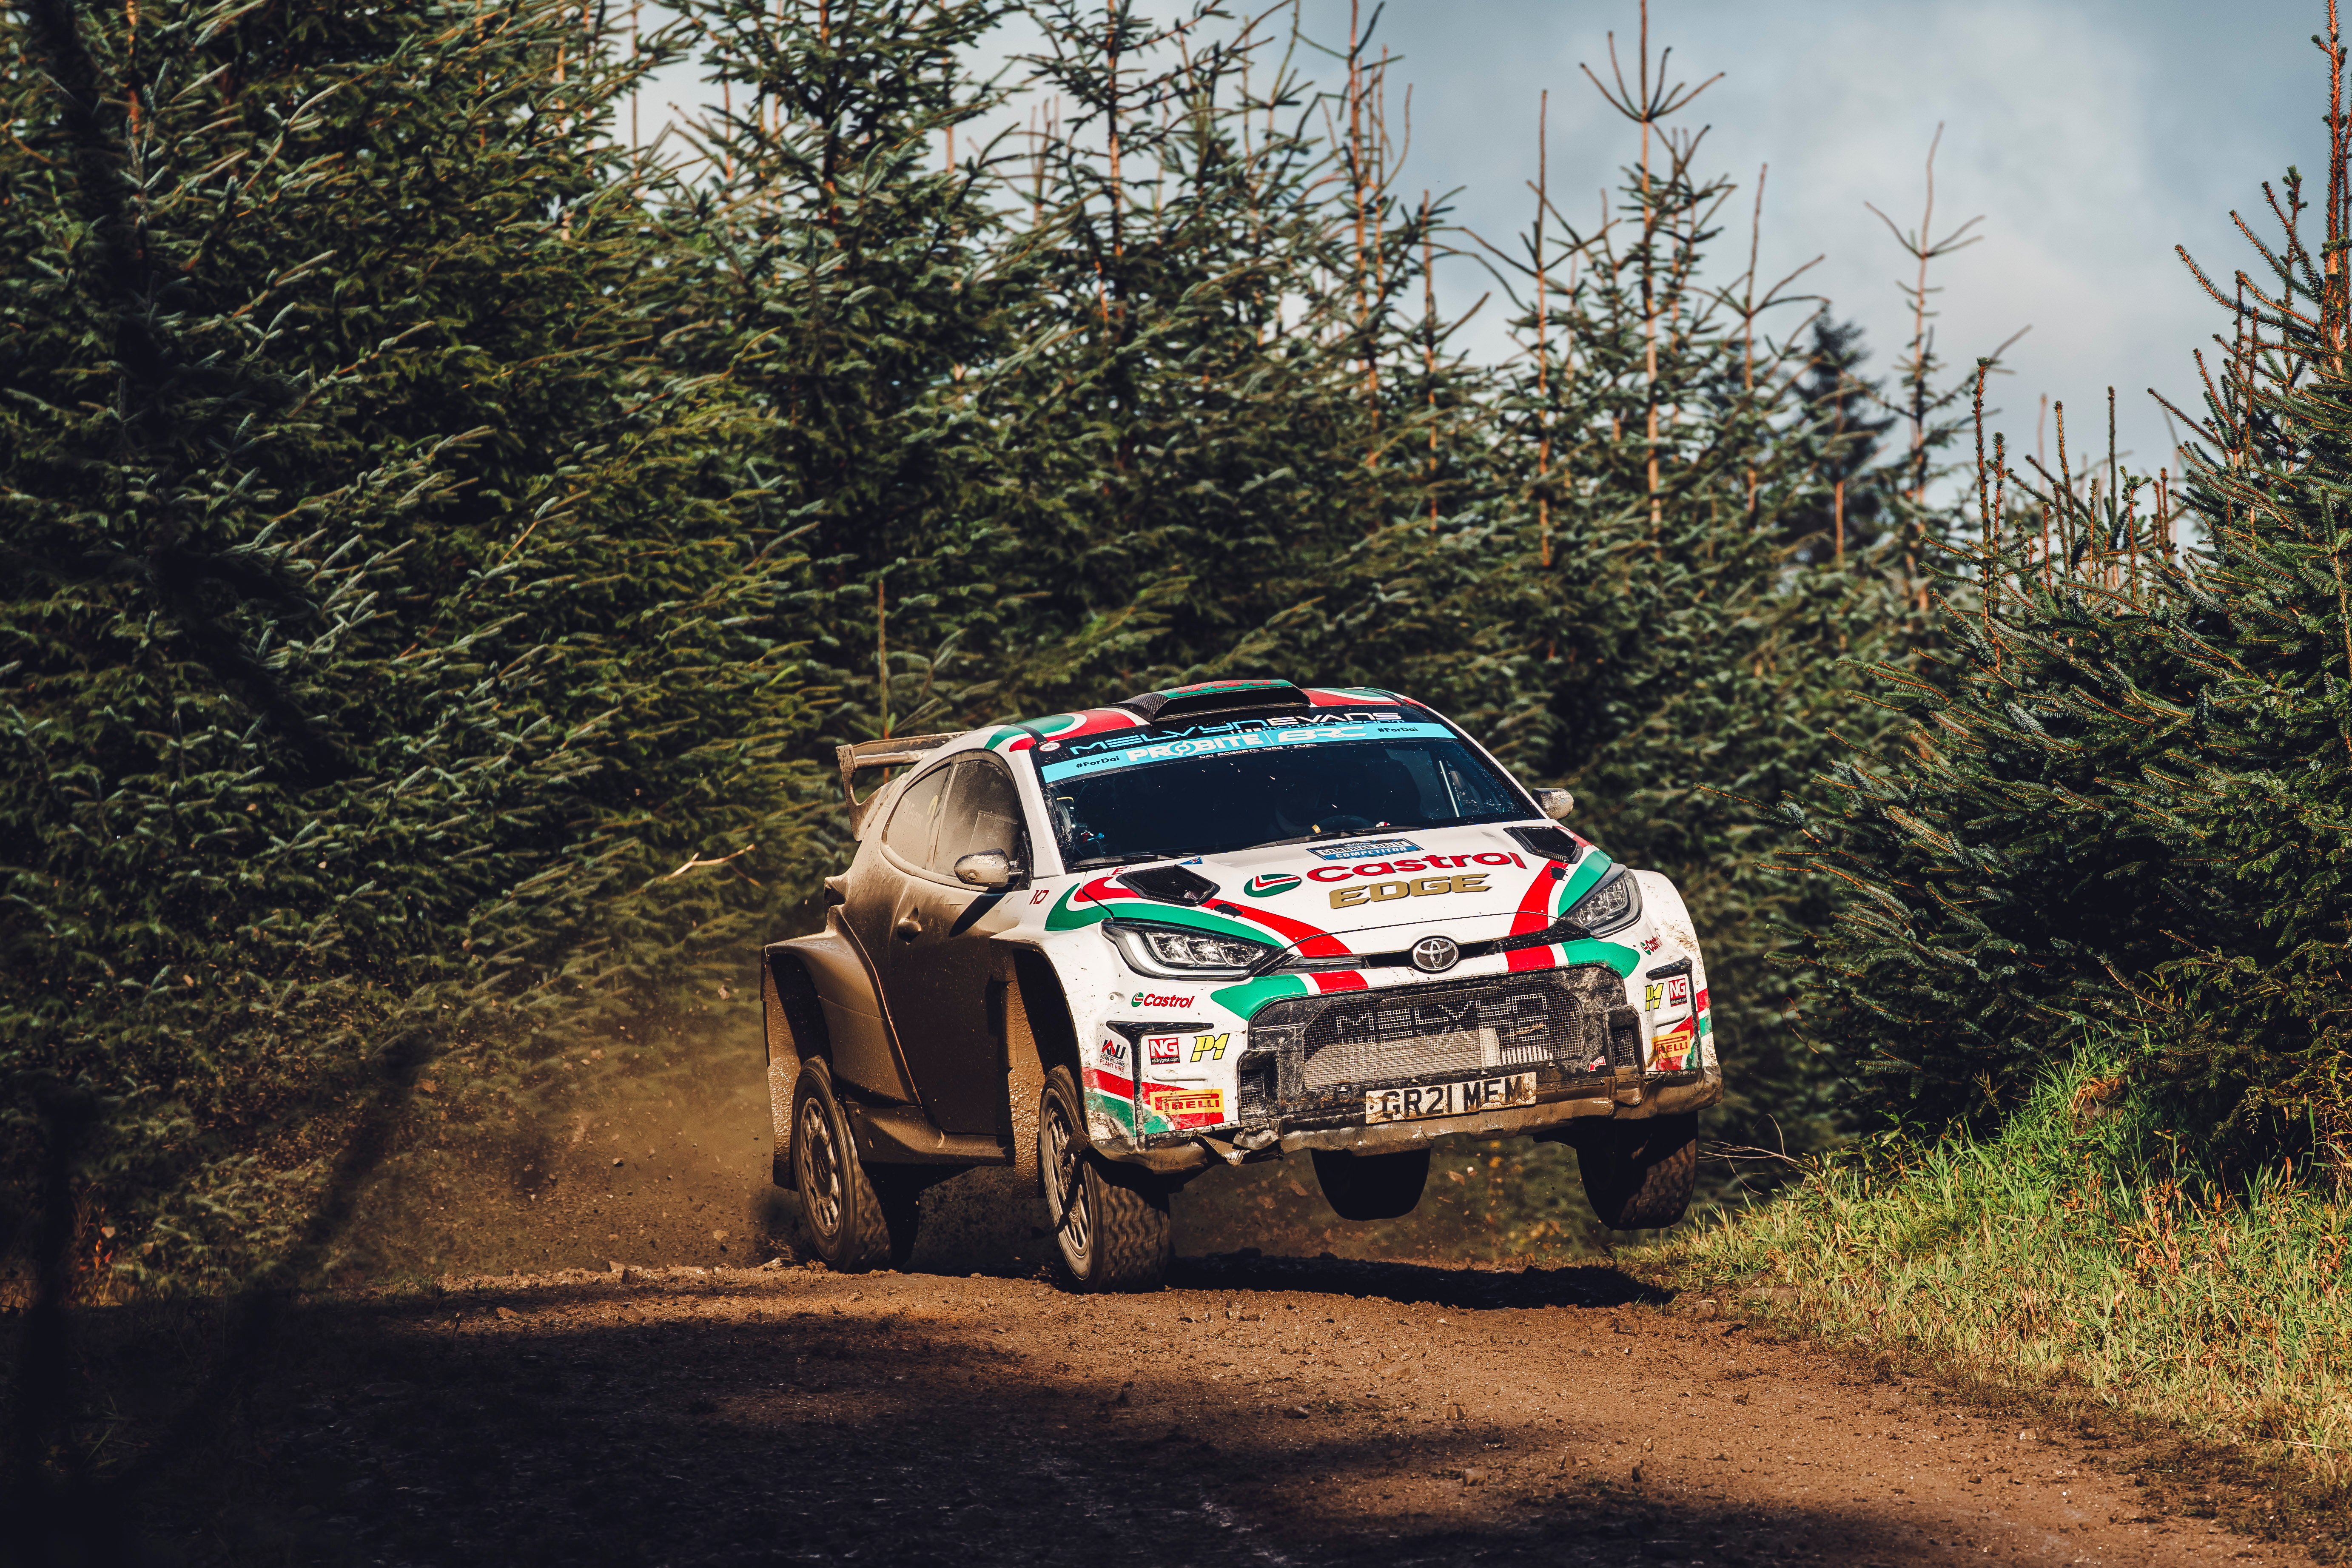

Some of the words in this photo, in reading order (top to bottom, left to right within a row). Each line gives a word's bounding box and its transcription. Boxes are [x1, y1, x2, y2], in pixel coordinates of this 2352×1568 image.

[1278, 726, 1368, 743] BRC
[1076, 756, 1120, 768] #ForDai
[1321, 845, 1374, 854] CAMBRIAN
[1335, 847, 1407, 858] COMPETITOR
[1307, 851, 1528, 882] Castrol
[1329, 873, 1491, 909] EDGE
[1669, 979, 1686, 998] NG
[1144, 993, 1195, 1008] Castrol
[1150, 1039, 1178, 1057] NG
[1190, 1033, 1230, 1063] P1
[1100, 1059, 1113, 1068] PLANT
[1114, 1064, 1125, 1073] HIRE
[1110, 1057, 1125, 1067] WILLIAMS
[1155, 1093, 1219, 1110] PIRELLI
